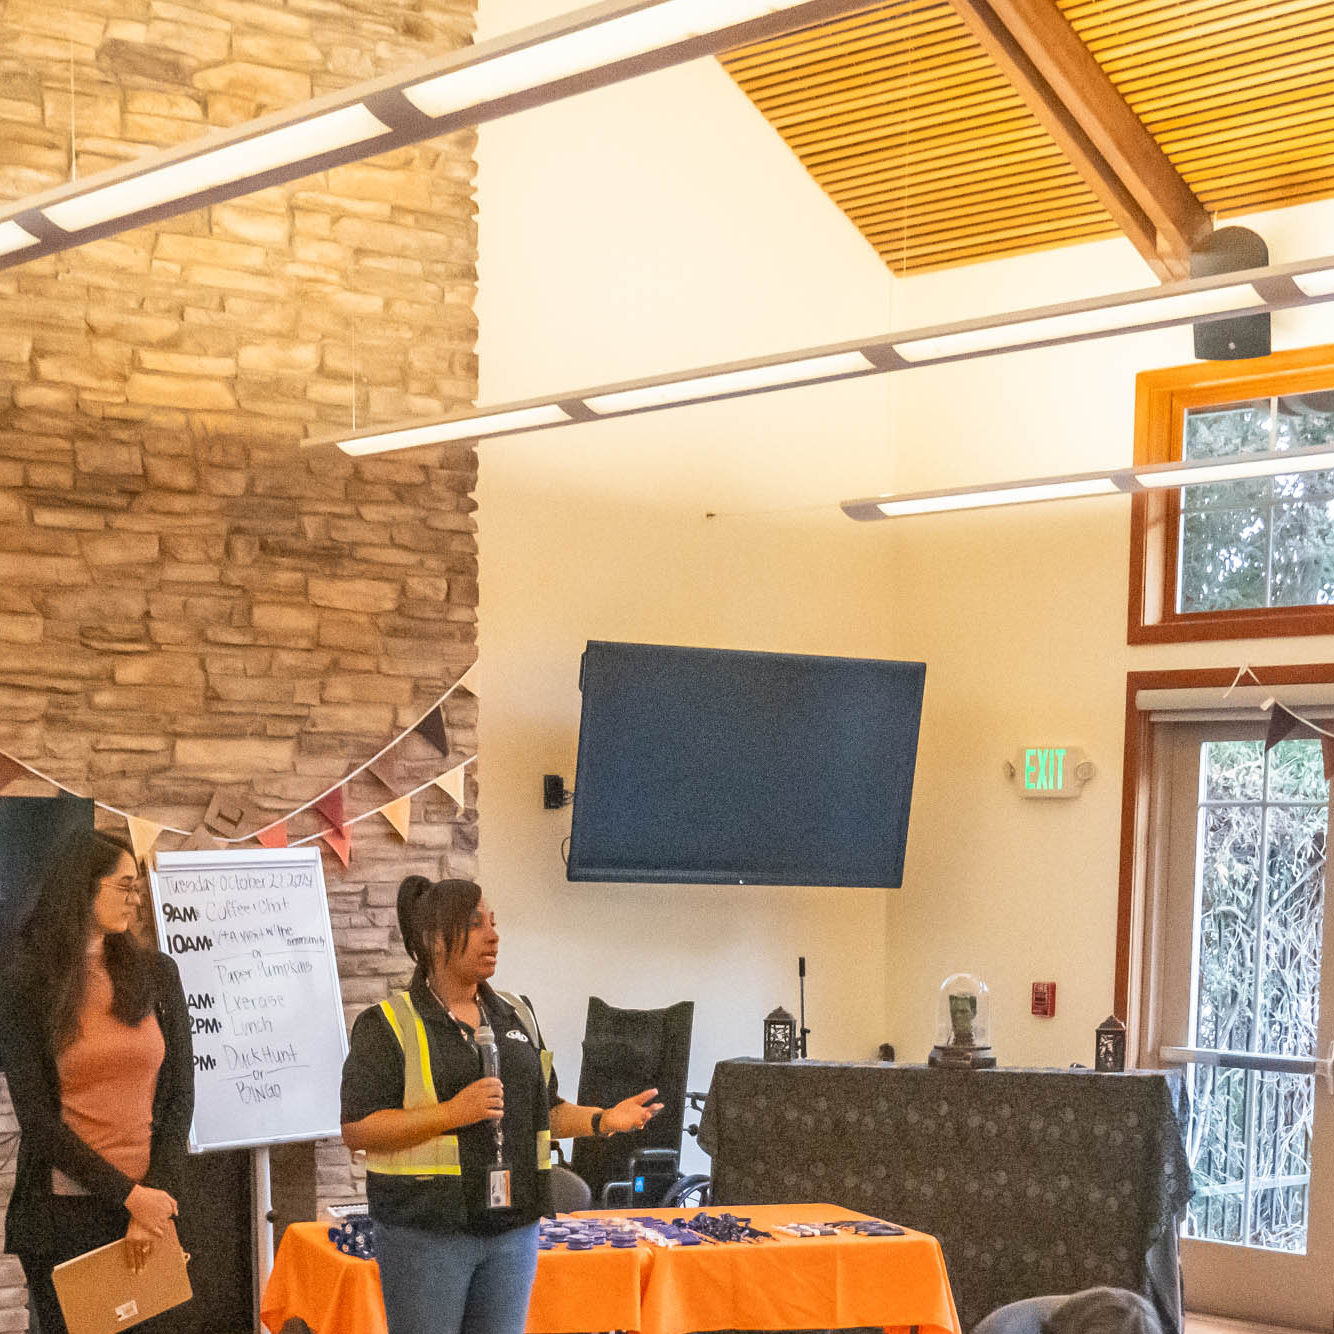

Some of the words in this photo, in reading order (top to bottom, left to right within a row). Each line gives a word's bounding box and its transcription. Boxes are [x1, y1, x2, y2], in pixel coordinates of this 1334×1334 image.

[1025, 748, 1067, 790] EXIT
[161, 874, 216, 896] Tuesday
[219, 873, 266, 892] October
[167, 934, 213, 954] 10AM:
[215, 965, 252, 986] Paper
[230, 1015, 273, 1037] Lunch
